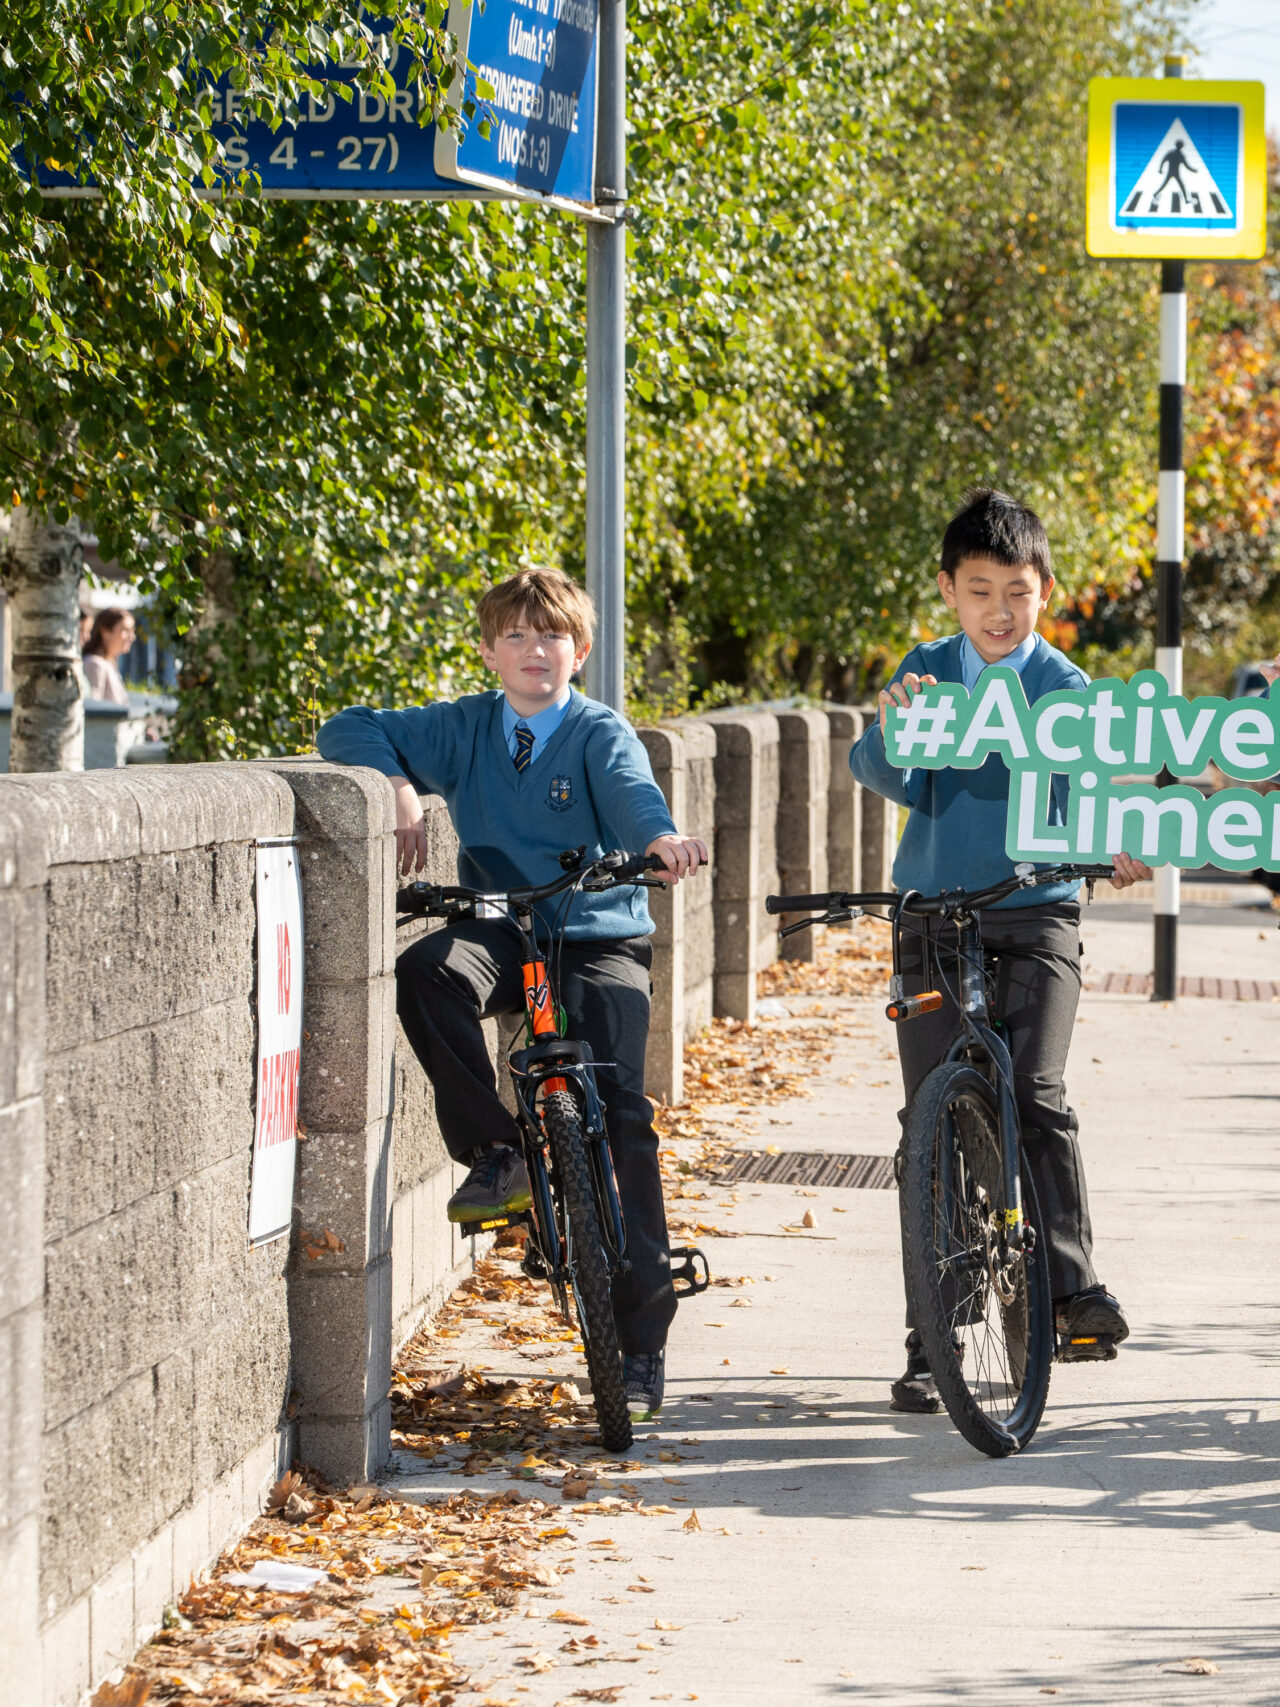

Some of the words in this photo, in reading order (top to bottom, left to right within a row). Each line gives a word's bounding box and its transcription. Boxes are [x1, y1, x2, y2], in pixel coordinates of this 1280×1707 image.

[476, 64, 544, 121] SPRINGFIELD
[547, 89, 579, 134] DRIVE
[269, 136, 298, 170] 4
[336, 132, 399, 173] 27)
[276, 920, 291, 1016] NO
[258, 1046, 300, 1150] PARKING
